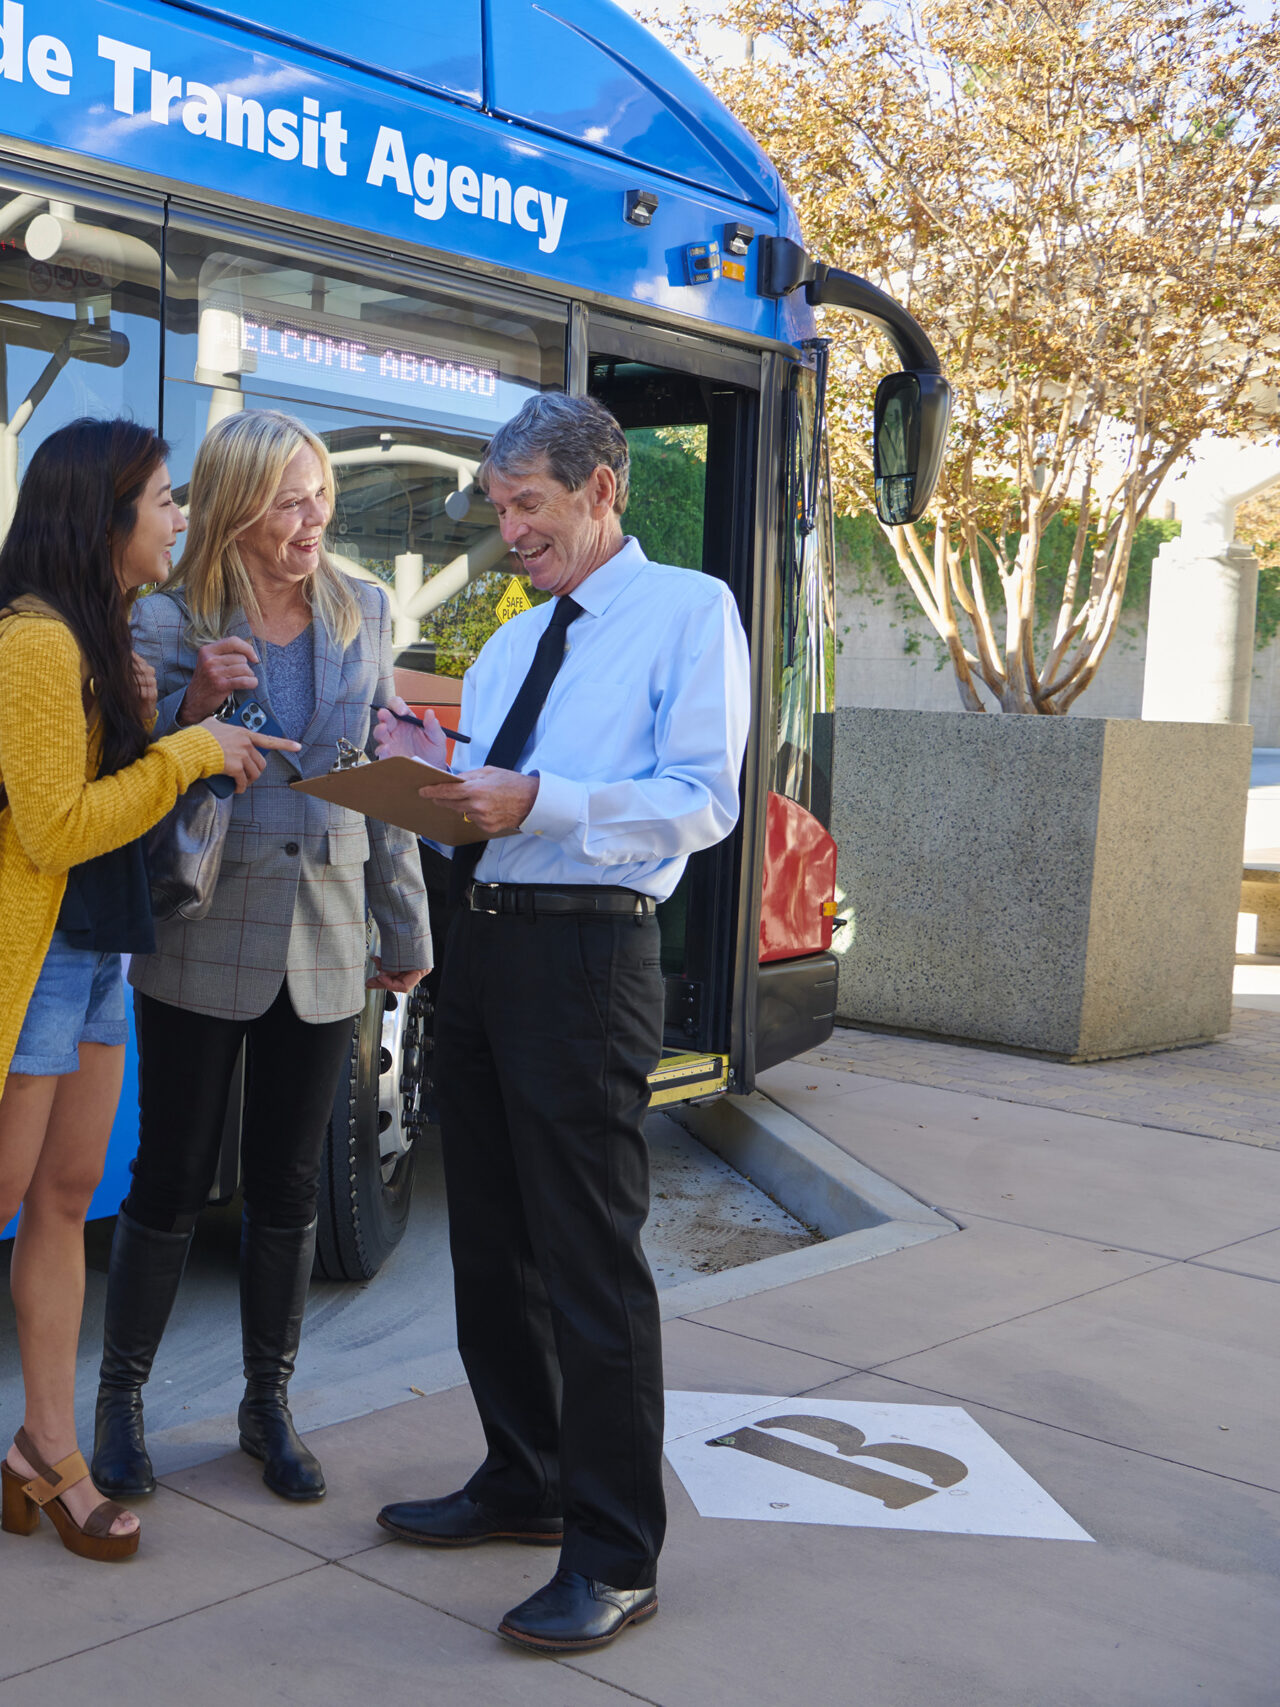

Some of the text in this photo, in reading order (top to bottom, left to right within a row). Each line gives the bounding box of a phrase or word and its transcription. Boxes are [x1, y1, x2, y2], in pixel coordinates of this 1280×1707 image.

[97, 35, 348, 177] Transit
[367, 126, 568, 254] Agency
[379, 349, 497, 397] ABOARD
[502, 608, 527, 620] PLA
[506, 596, 524, 608] SAFE
[704, 1414, 969, 1510] B
